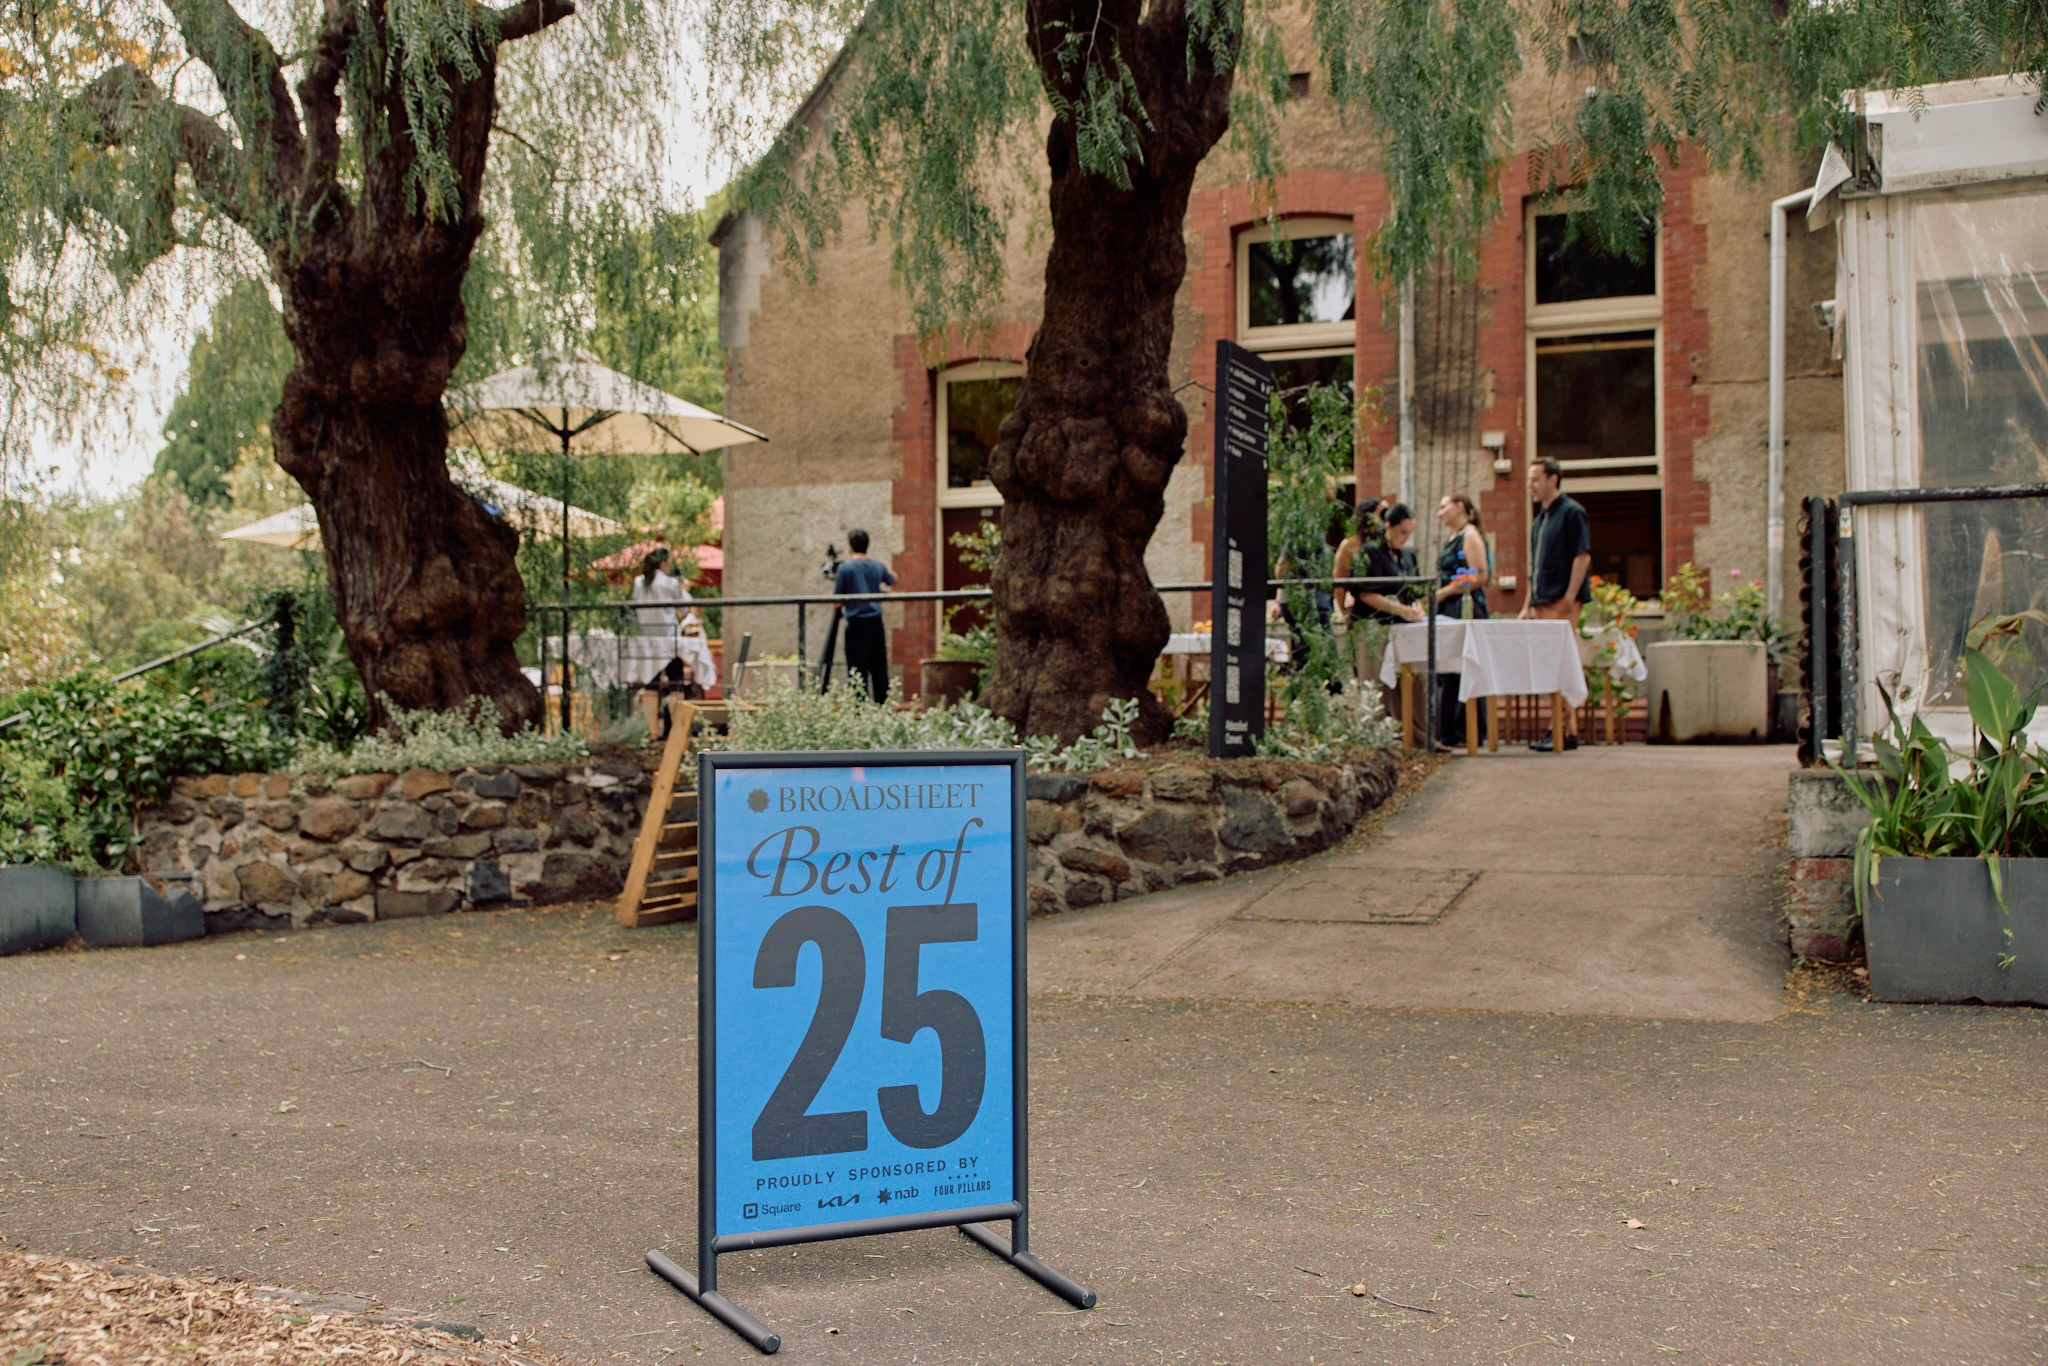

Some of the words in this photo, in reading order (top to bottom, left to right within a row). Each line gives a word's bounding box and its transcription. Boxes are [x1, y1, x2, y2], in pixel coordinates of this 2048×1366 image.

[777, 783, 984, 813] BROADSHEET
[746, 825, 906, 898] Best
[915, 817, 984, 914] of
[751, 902, 986, 1161] 25
[756, 1171, 835, 1190] PROUDLY
[848, 1160, 947, 1181] SPONSORED
[959, 1156, 978, 1169] BY
[894, 1186, 919, 1199] nab
[934, 1185, 955, 1197] FOUR
[957, 1180, 991, 1194] PILLARS
[761, 1203, 802, 1217] Square
